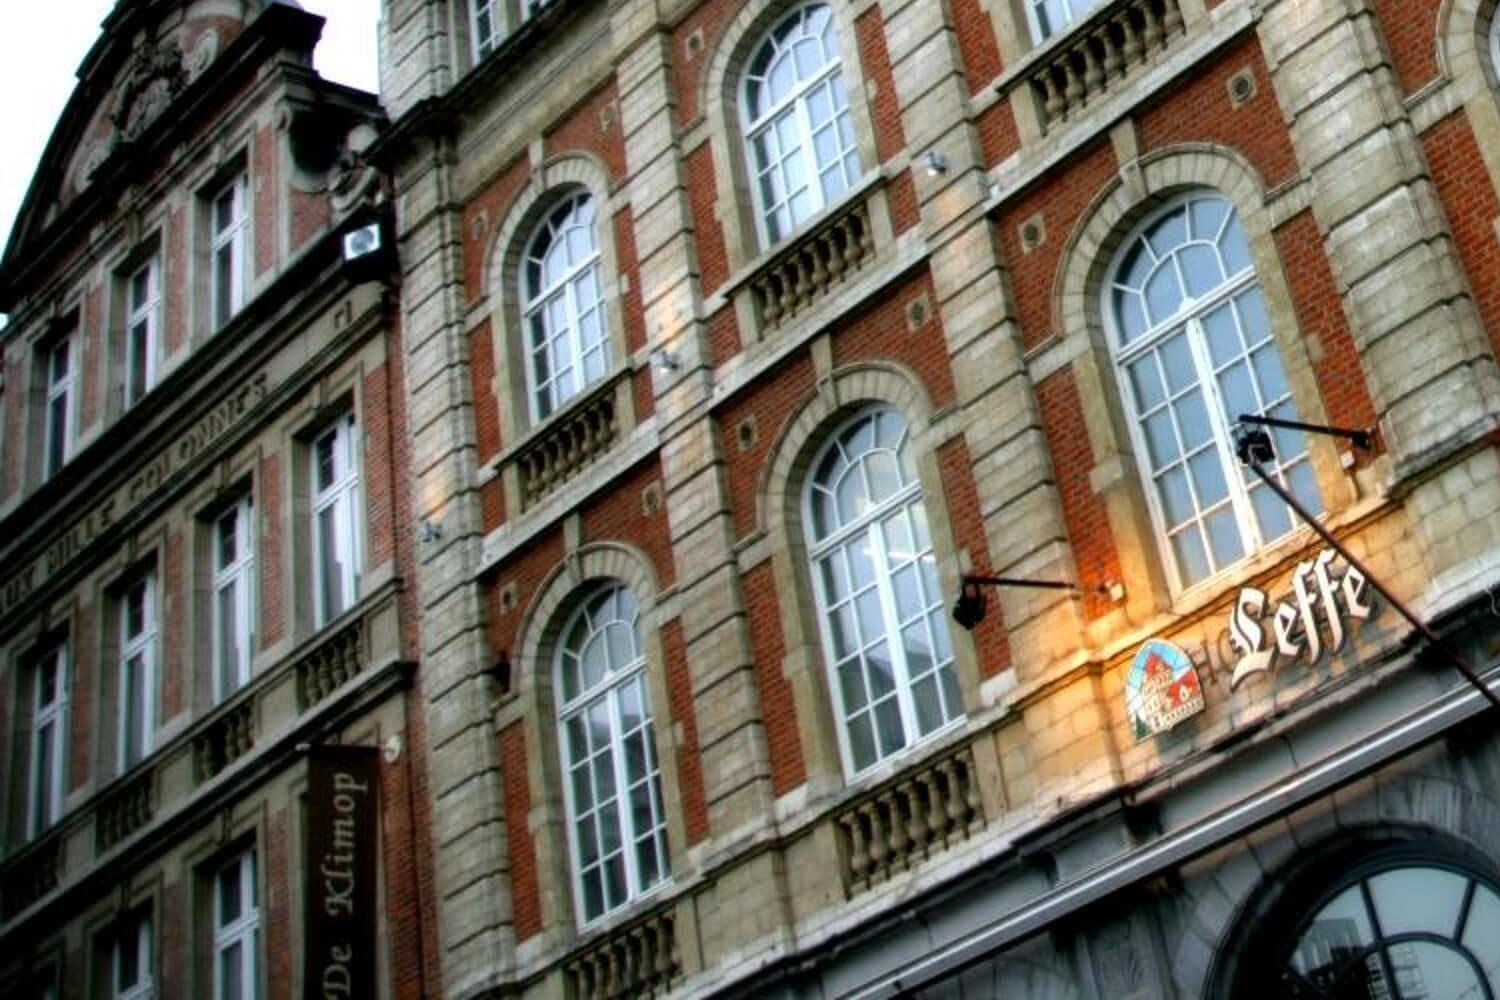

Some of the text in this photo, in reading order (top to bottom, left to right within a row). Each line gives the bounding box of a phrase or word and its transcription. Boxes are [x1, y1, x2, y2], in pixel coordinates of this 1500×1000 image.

[1229, 549, 1372, 693] Leffe
[320, 772, 368, 1000] De Klimop
